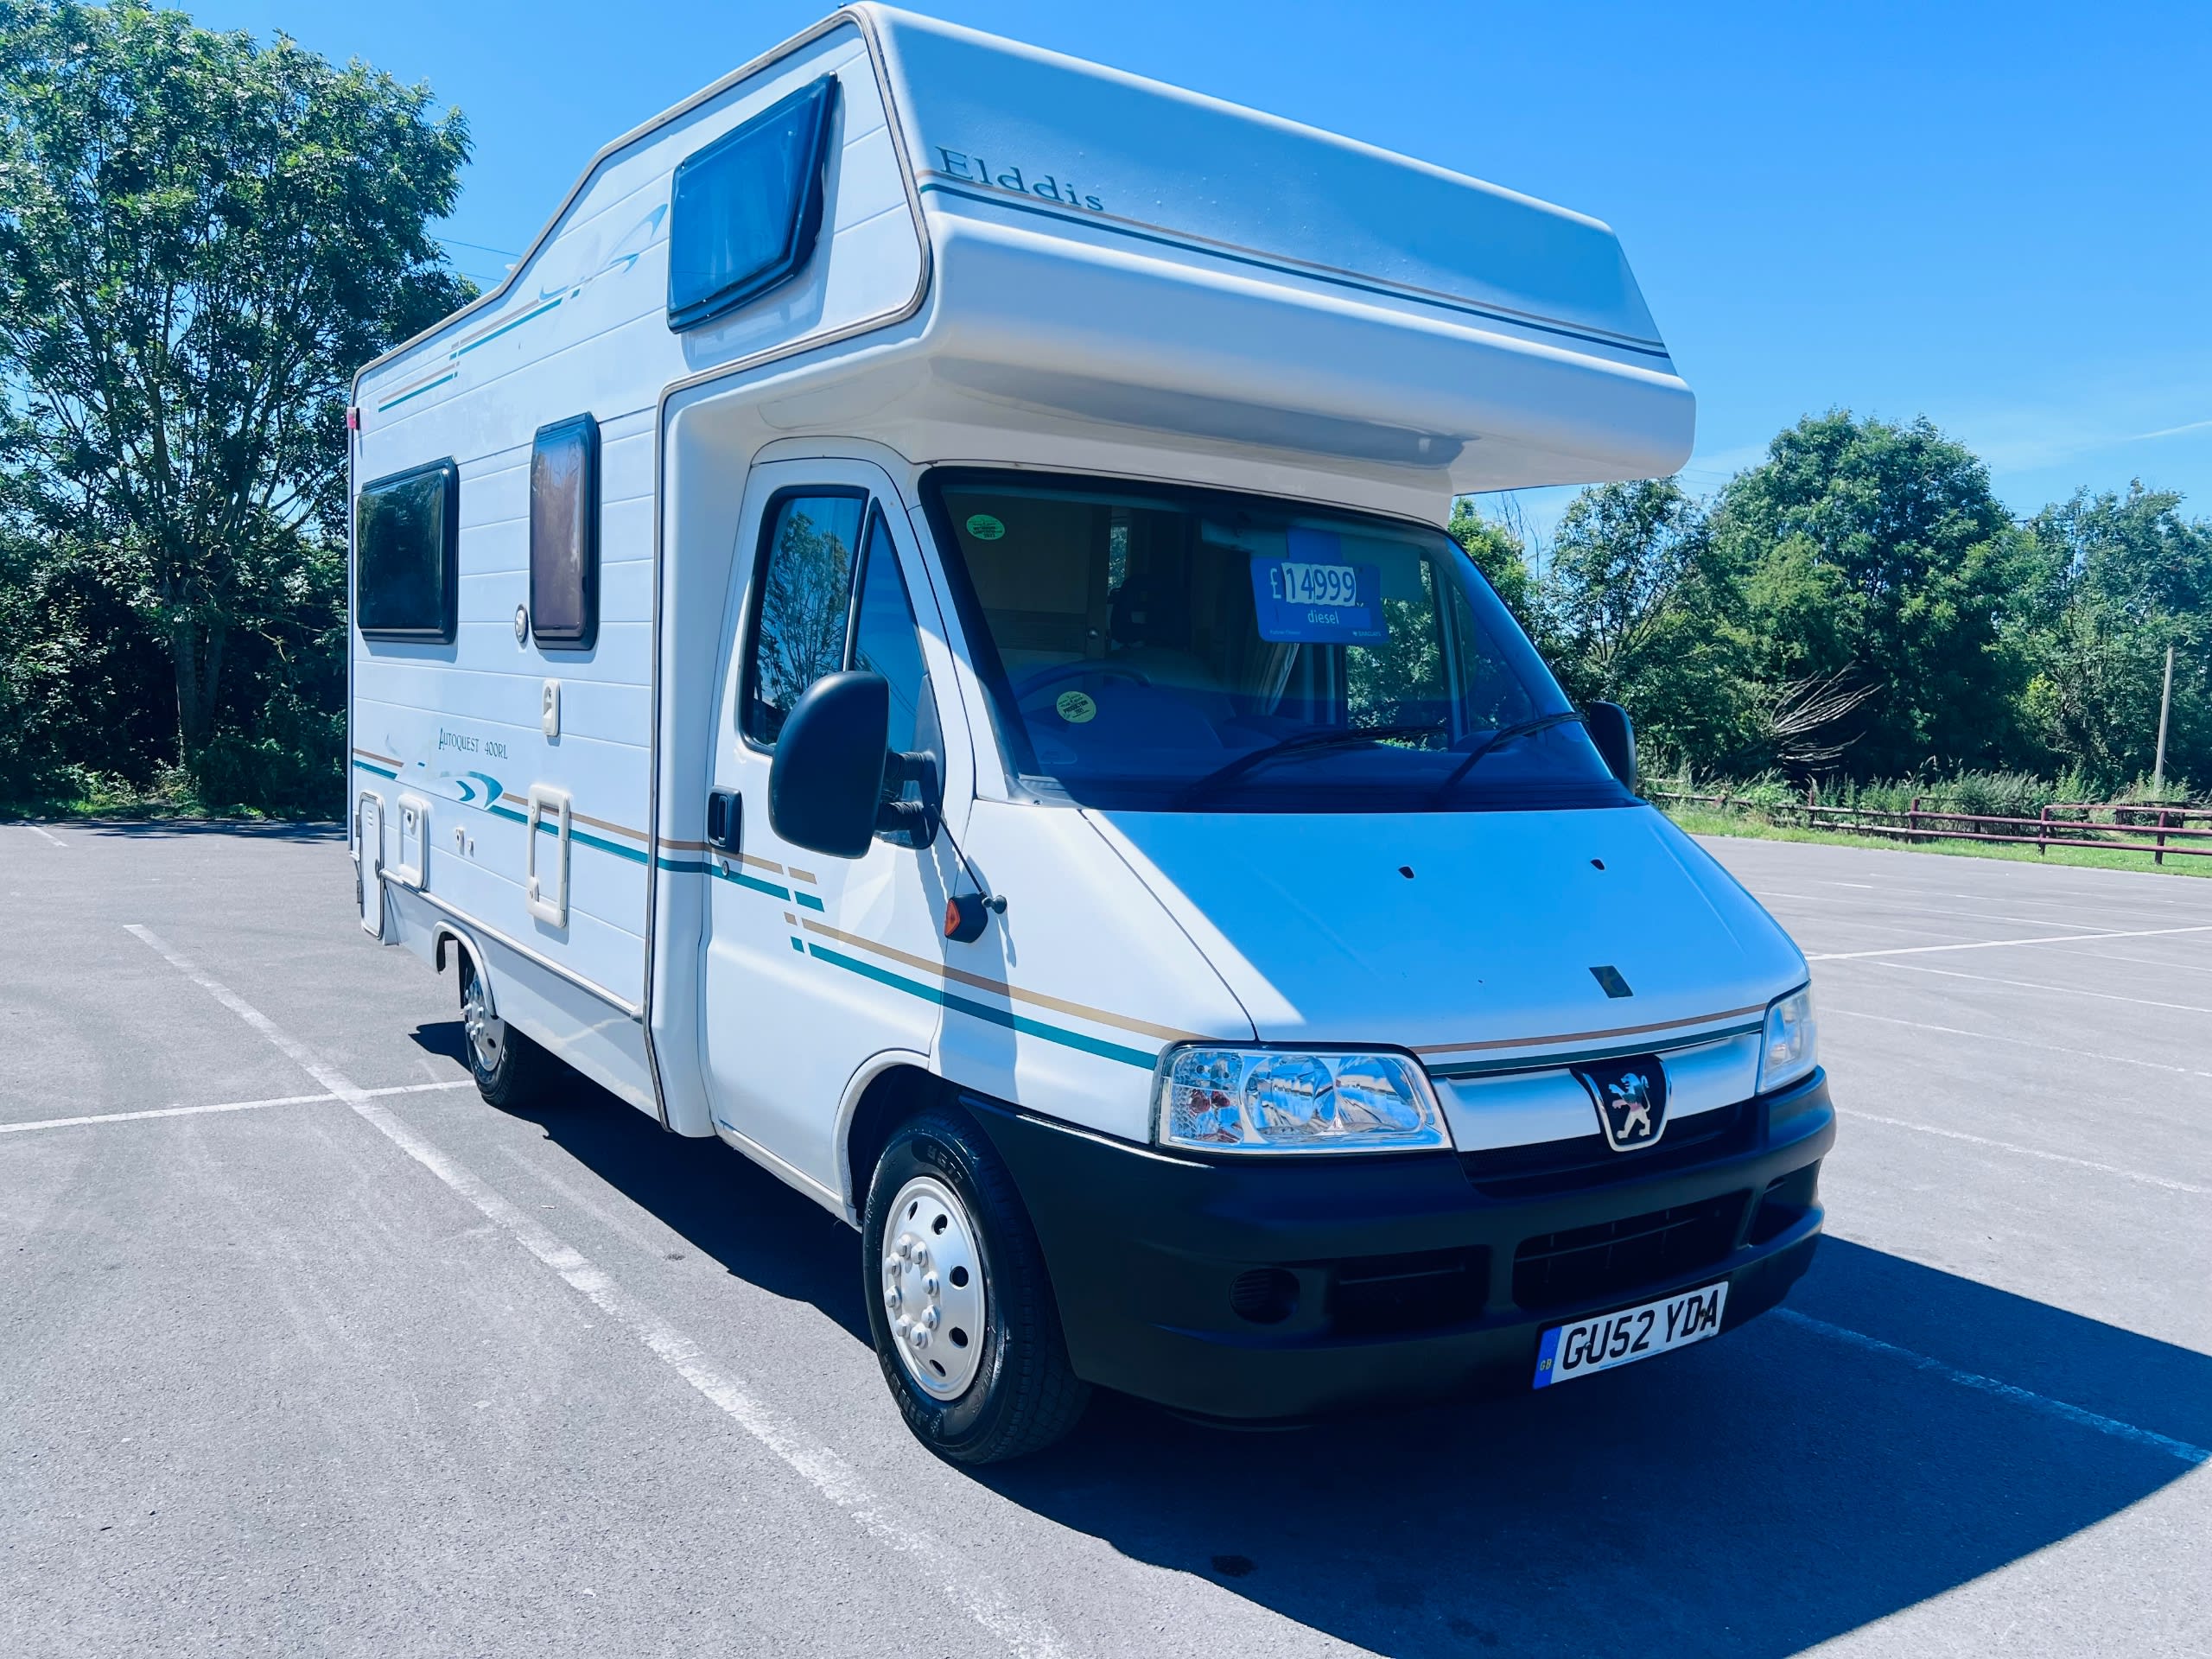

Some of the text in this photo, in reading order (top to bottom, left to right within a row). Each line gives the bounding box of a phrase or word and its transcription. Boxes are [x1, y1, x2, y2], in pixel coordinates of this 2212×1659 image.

[935, 145, 1104, 212] Elddis
[1269, 567, 1356, 603] £14999
[1307, 608, 1339, 625] diesel
[438, 727, 508, 760] AUTOQUEST 400RL
[1562, 1289, 1719, 1370] GU52 YDA
[1539, 1357, 1553, 1371] GB
